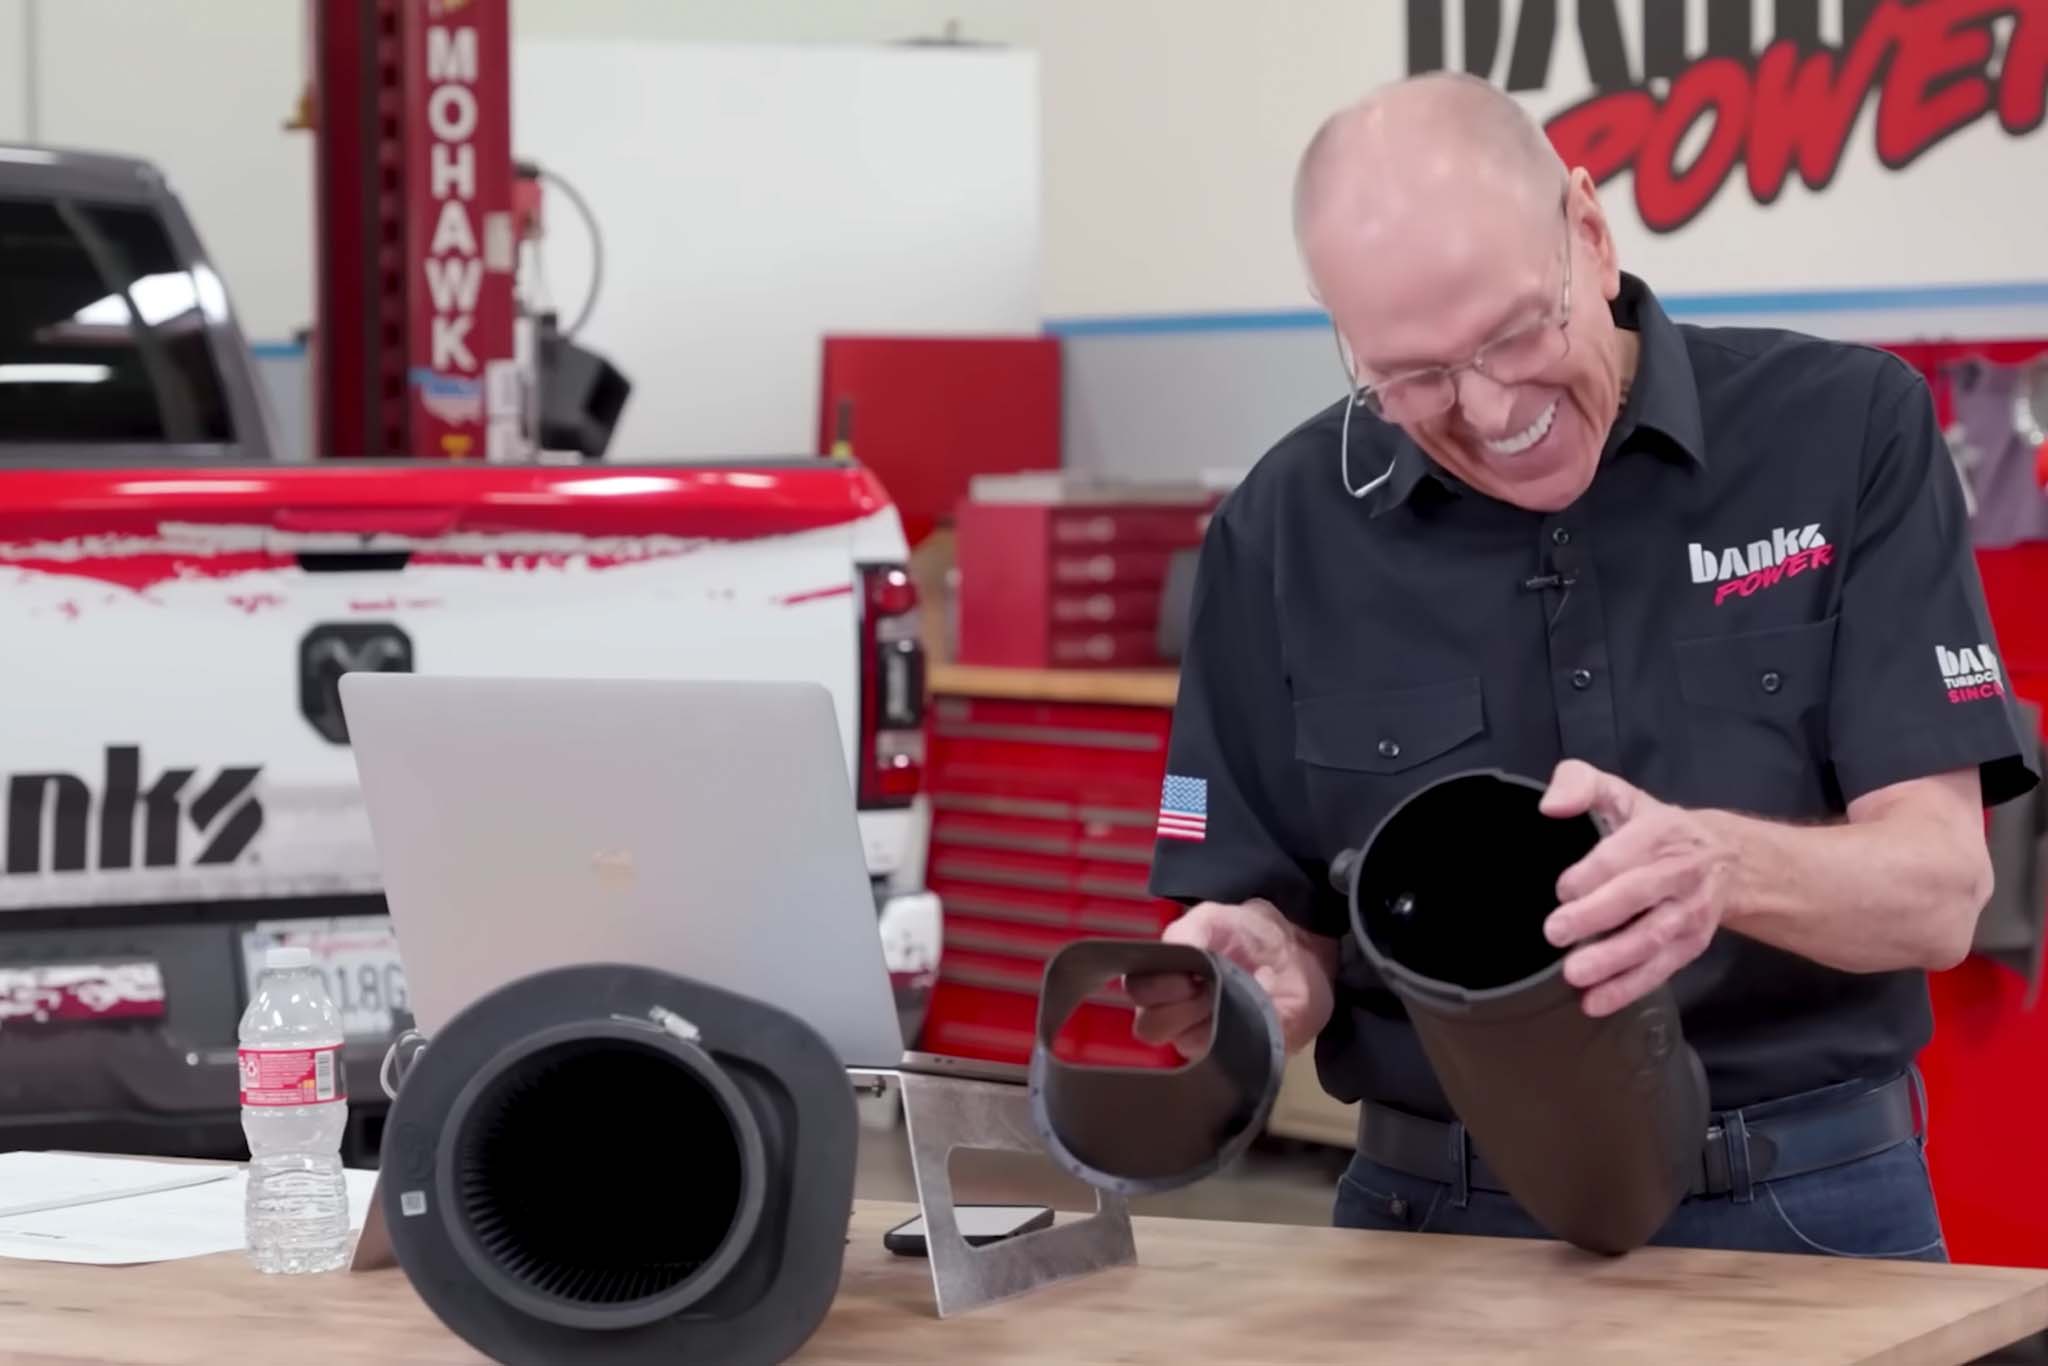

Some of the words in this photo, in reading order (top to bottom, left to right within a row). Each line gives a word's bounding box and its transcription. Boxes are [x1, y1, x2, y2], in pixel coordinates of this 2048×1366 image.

[425, 26, 482, 371] MOHAWK
[1688, 523, 1826, 583] banks
[1714, 543, 1834, 606] POWER
[1944, 670, 2000, 688] TURBOC
[0, 745, 264, 875] nks
